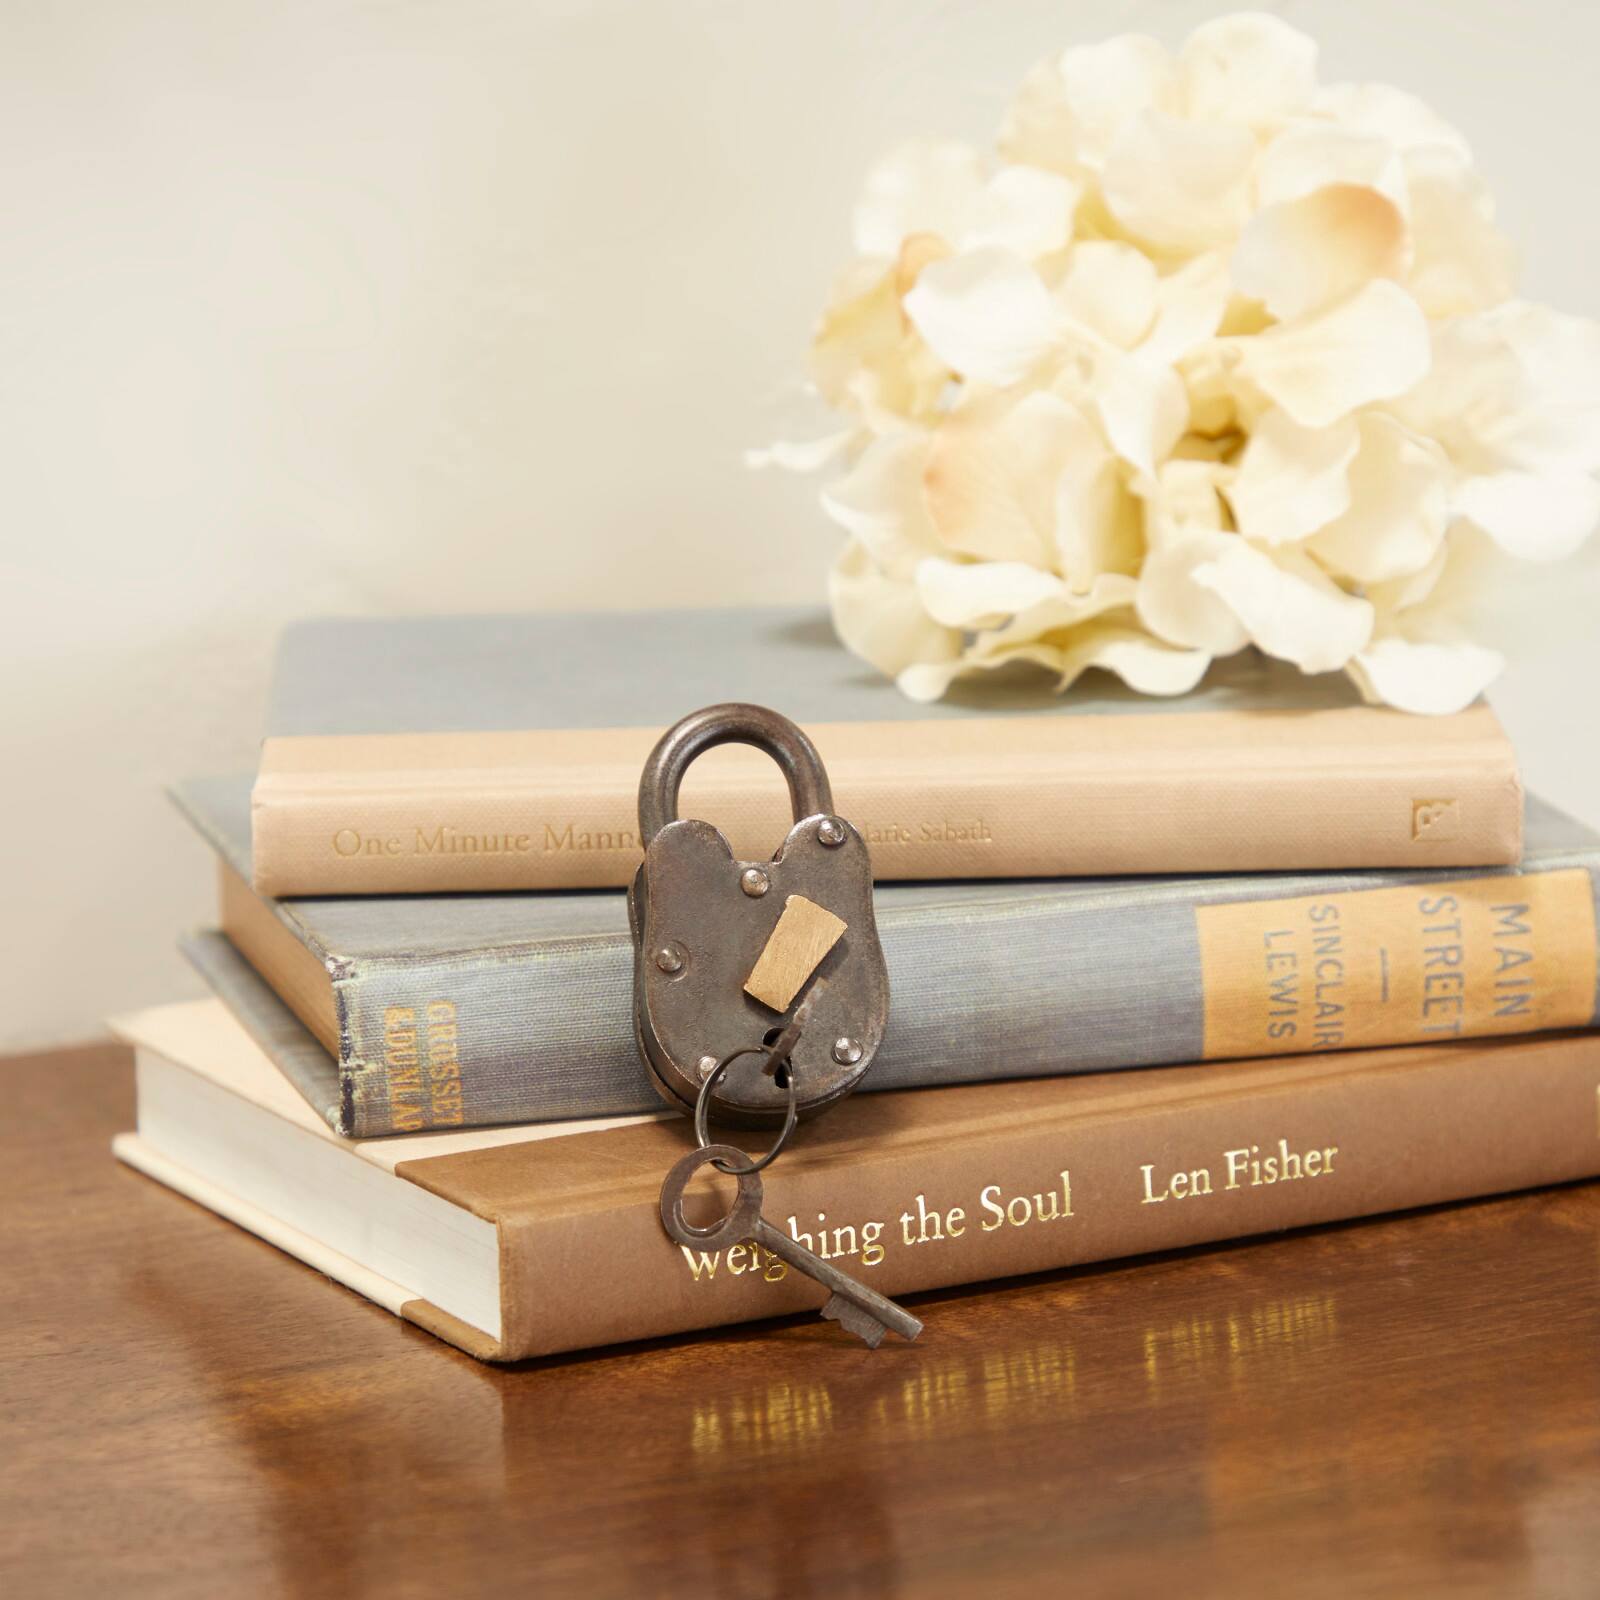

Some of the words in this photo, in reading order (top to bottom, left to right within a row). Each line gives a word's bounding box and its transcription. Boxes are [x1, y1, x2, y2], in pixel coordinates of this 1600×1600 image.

[332, 828, 401, 858] One
[413, 825, 530, 855] Minute
[542, 823, 645, 850] Mann
[919, 818, 992, 843] Sabath
[1263, 929, 1298, 1040] LEWIS
[1308, 903, 1345, 1048] SINCLAIR
[1418, 895, 1465, 1036] STREET
[1489, 903, 1536, 1018] MAIN
[426, 999, 465, 1126] GROSSET
[899, 1194, 967, 1246] the
[979, 1170, 1076, 1233] Soul
[1139, 1164, 1212, 1205] Len
[1223, 1138, 1339, 1191] Fisher
